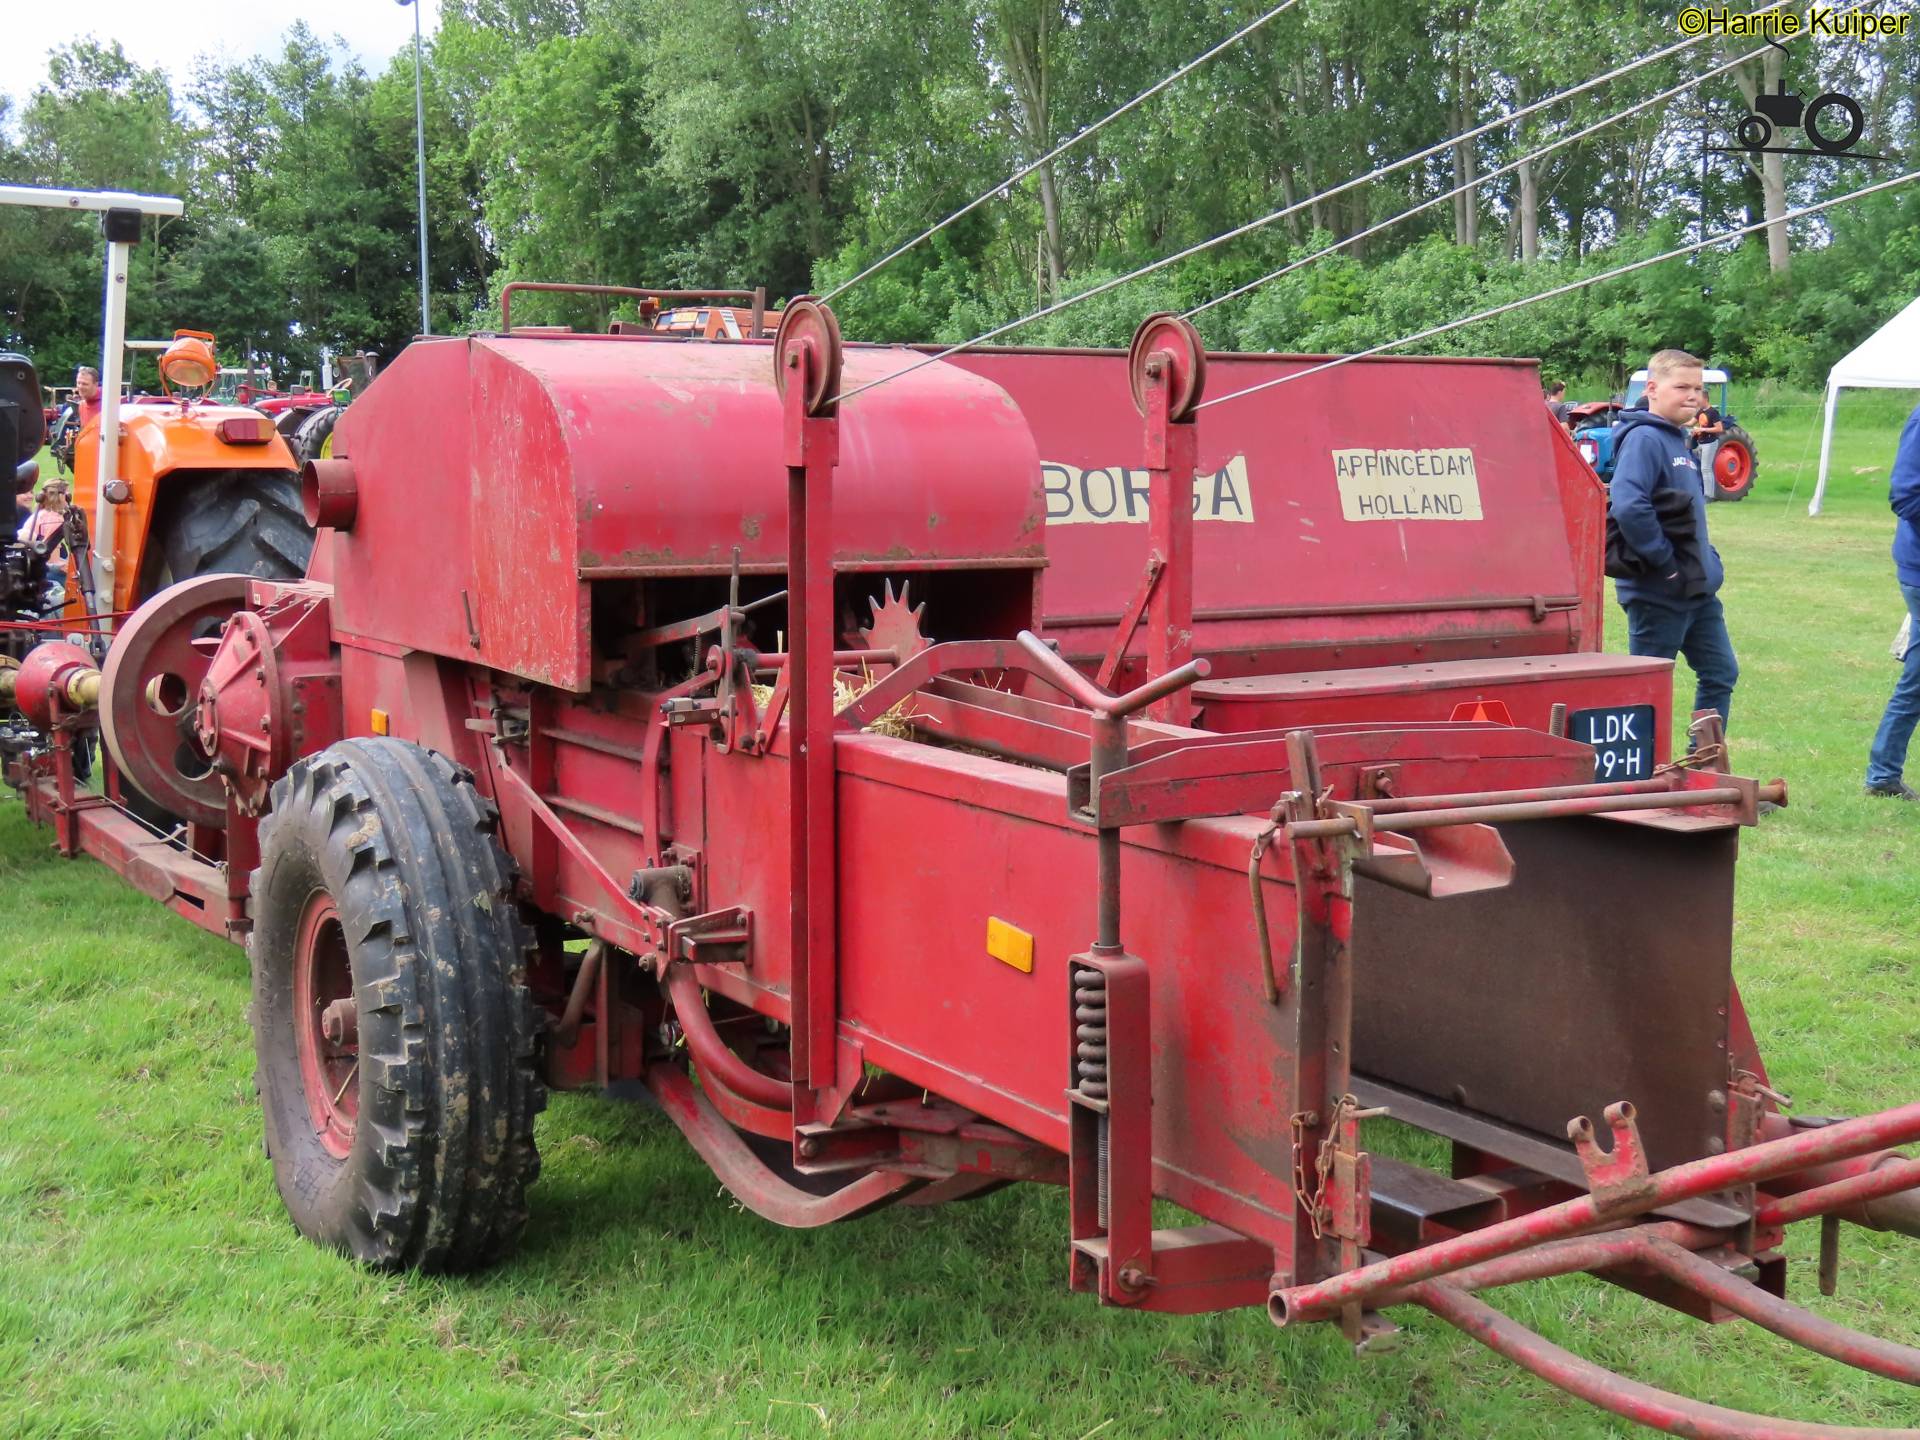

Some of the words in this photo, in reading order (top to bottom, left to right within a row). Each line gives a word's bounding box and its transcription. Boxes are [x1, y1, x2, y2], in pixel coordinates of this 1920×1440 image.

[1337, 454, 1474, 478] APPINGEDAM
[1358, 494, 1463, 516] HOLLAND
[1589, 712, 1638, 744] LDK
